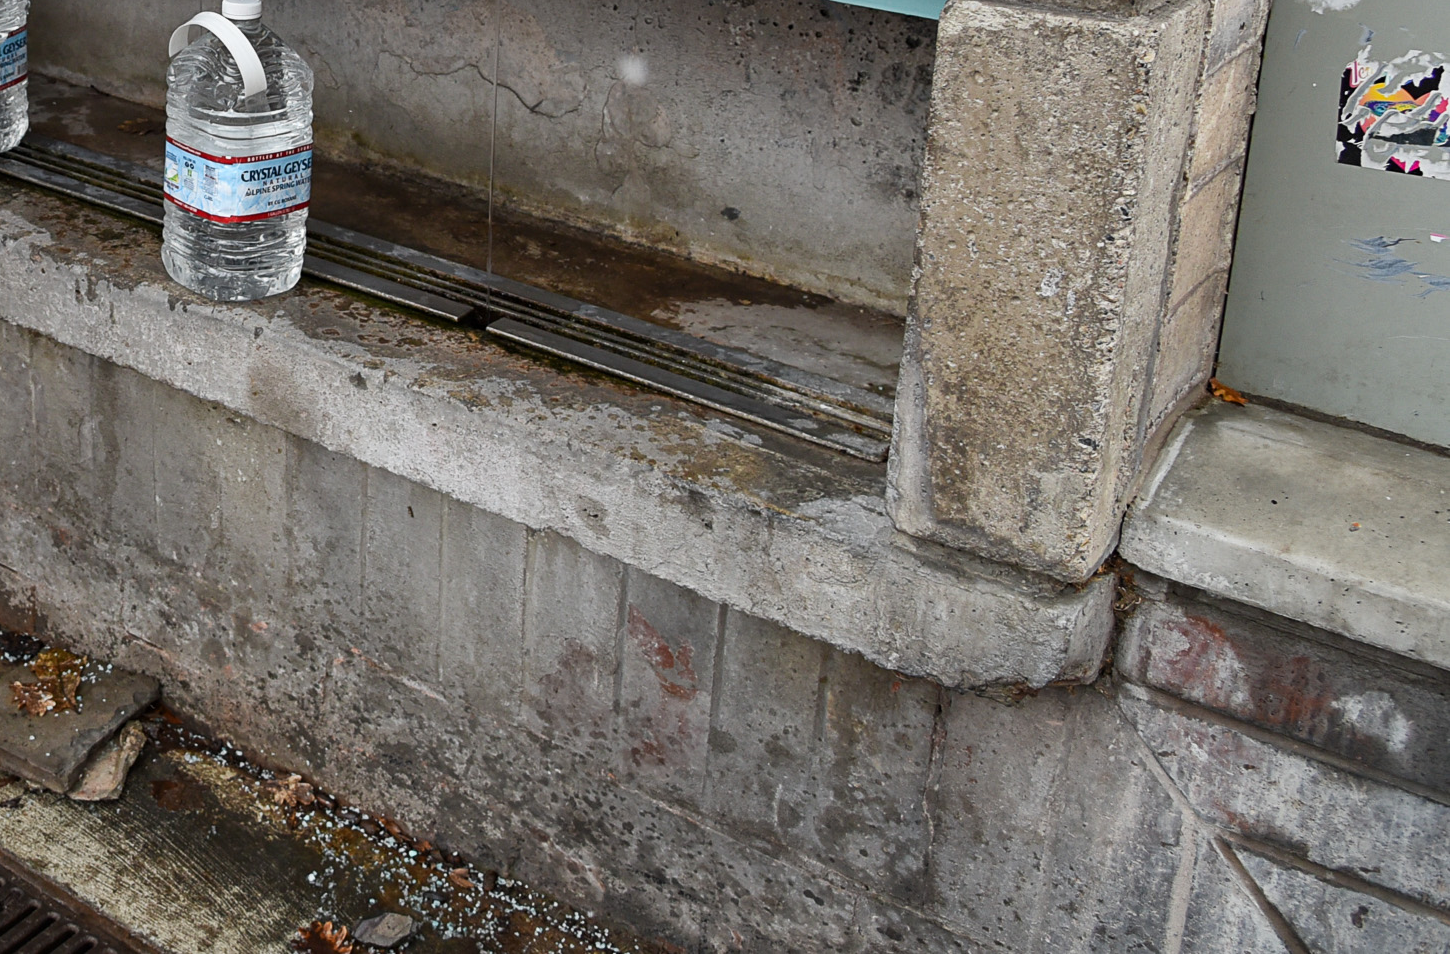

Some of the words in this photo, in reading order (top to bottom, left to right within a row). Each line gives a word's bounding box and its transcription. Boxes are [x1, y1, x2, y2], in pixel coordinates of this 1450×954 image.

[247, 153, 273, 163] BOTTLED
[241, 165, 282, 183] CRYSTAL
[283, 157, 313, 175] GEYSE
[245, 187, 271, 197] ALPINE
[271, 181, 296, 193] SPRING
[295, 177, 312, 187] WATE
[262, 173, 304, 187] NATURAL
